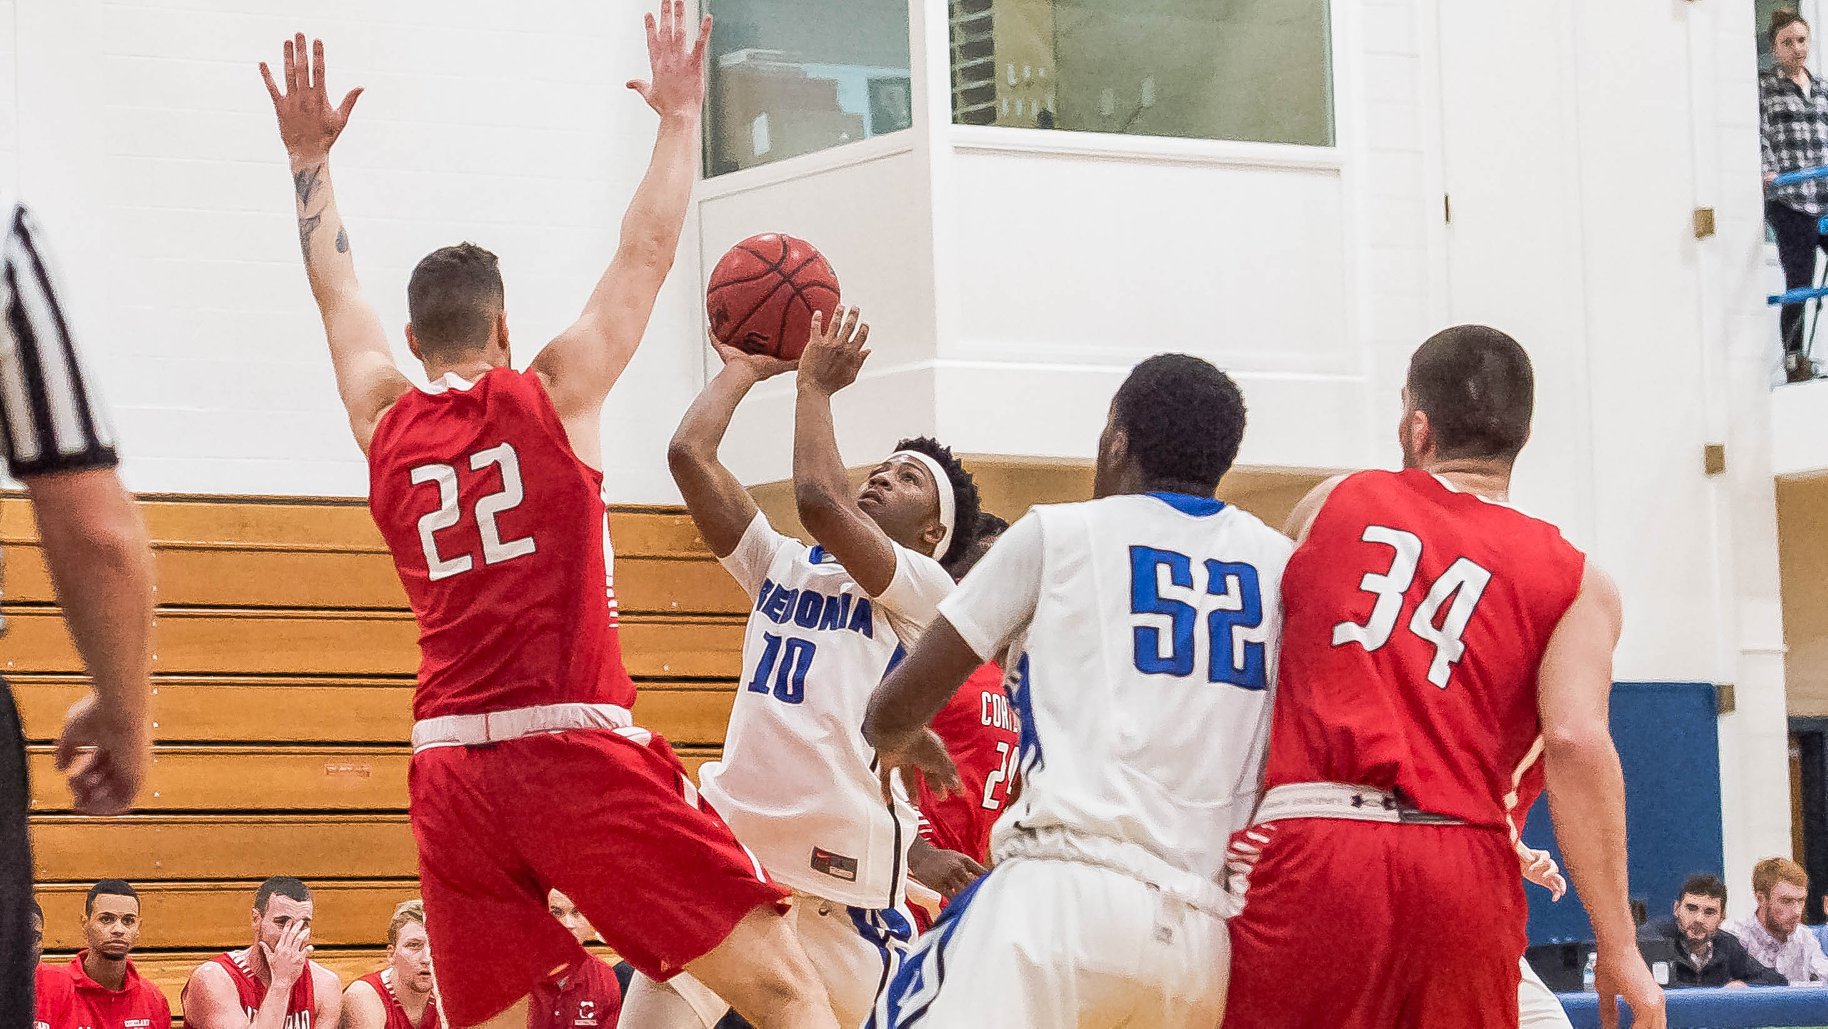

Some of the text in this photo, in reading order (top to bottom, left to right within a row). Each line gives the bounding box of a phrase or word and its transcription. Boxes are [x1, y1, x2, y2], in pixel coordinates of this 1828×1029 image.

[409, 441, 537, 582] 22
[747, 630, 817, 704] 10
[1129, 545, 1267, 690] 52
[1331, 525, 1492, 689] 34
